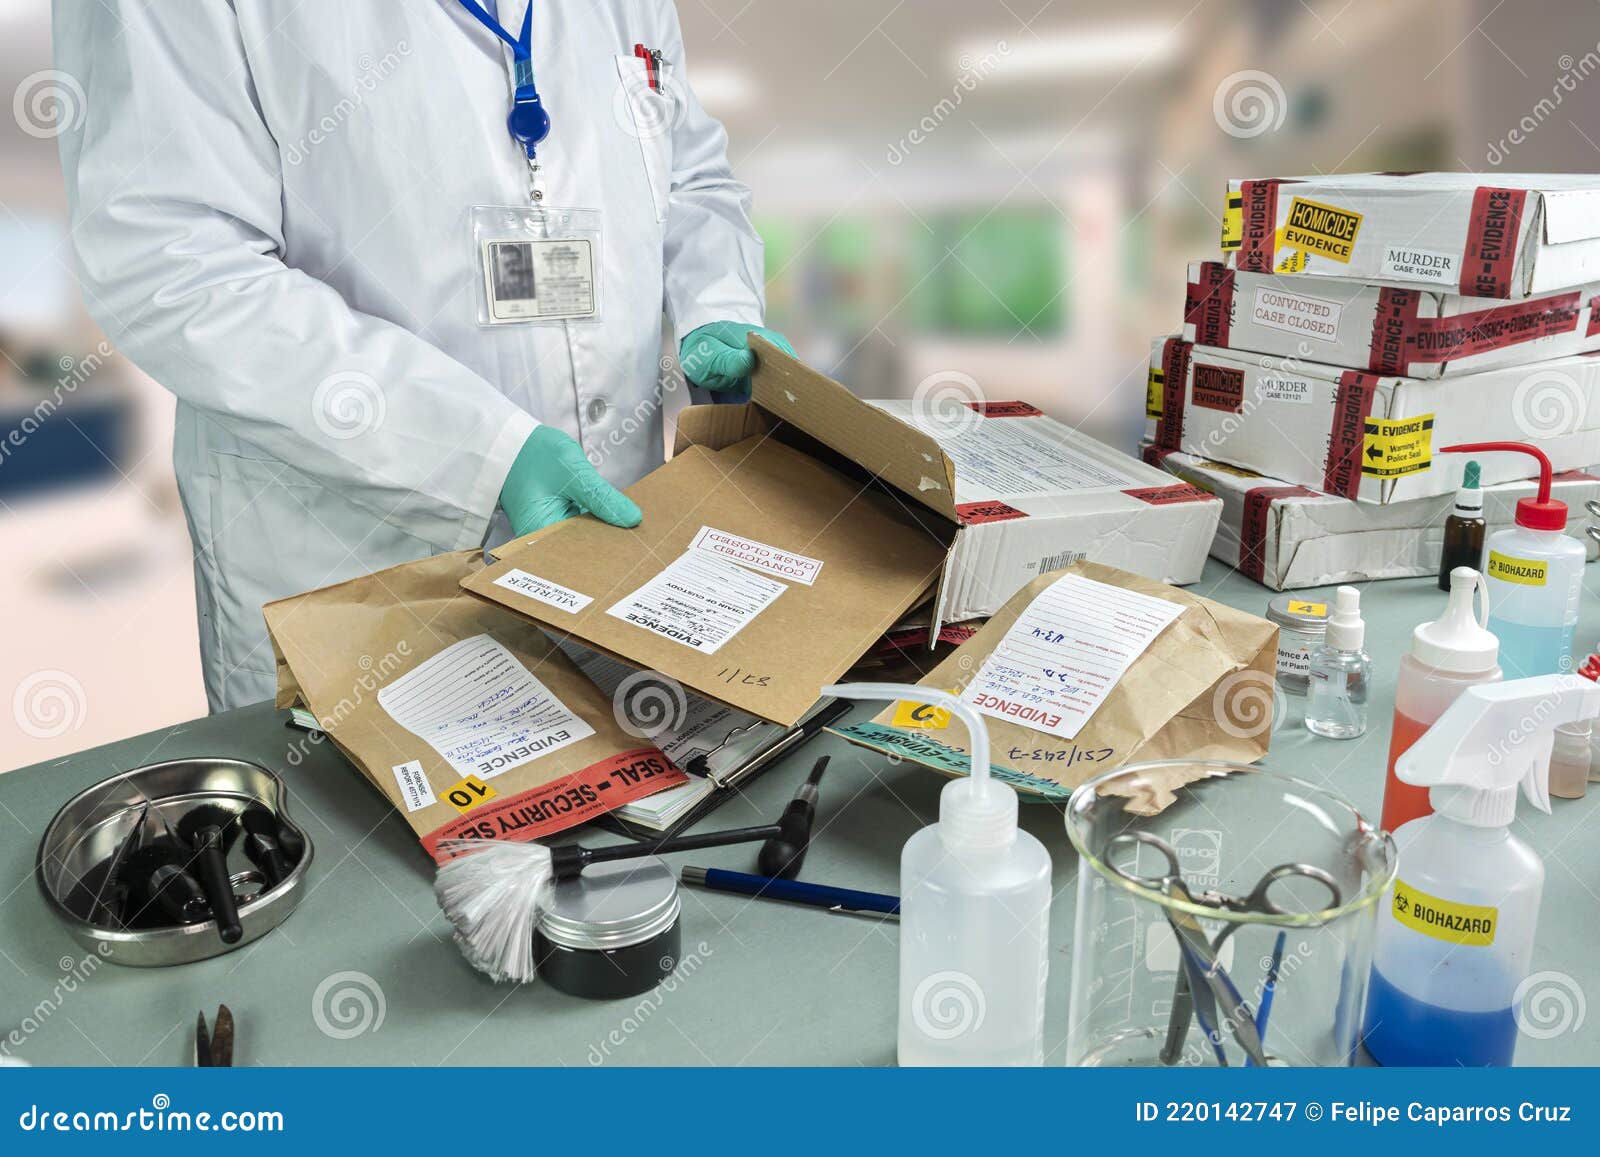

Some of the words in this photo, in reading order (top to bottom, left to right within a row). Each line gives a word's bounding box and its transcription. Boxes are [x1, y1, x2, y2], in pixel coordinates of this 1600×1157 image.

[1249, 182, 1268, 238] EVIDENCE
[1292, 204, 1356, 239] HOMICIDE
[1480, 191, 1511, 261] EVIDENCE
[1285, 230, 1350, 256] EVIDENCE
[1388, 250, 1451, 269] MURDER
[1393, 264, 1414, 274] CASE
[1415, 267, 1442, 277] 124576
[1262, 293, 1330, 318] CONVICTED
[1255, 308, 1285, 324] CASE
[1288, 315, 1336, 335] CLOSED
[1417, 327, 1465, 349] EVIDENCE
[1472, 319, 1504, 342] EVIDENCE
[1195, 367, 1241, 394] HOMICIDE
[1261, 379, 1307, 393] MURDER
[1342, 384, 1364, 445] EVIDENCE
[1383, 422, 1420, 436] EVIDENCE
[1386, 453, 1407, 463] Police
[710, 533, 770, 557] CLOSED
[713, 544, 805, 577] CONVICTED
[773, 553, 815, 571] CASE
[1498, 562, 1544, 579] BIOHAZARD
[508, 577, 578, 607] MURDER
[666, 582, 704, 600] CUSTODY
[718, 602, 745, 615] CHAIN
[1297, 605, 1315, 613] 4
[625, 613, 703, 647] EVIDENCE
[973, 692, 1062, 728] EVIDENCE
[478, 730, 572, 774] EVIDENCE
[868, 731, 941, 757] EVIDENCE
[400, 766, 413, 789] REPORT
[412, 770, 428, 796] FORENSIC
[610, 758, 668, 786] SEAL
[448, 781, 487, 807] 10
[500, 783, 598, 833] SECURITY
[1413, 903, 1491, 933] BIOHAZARD
